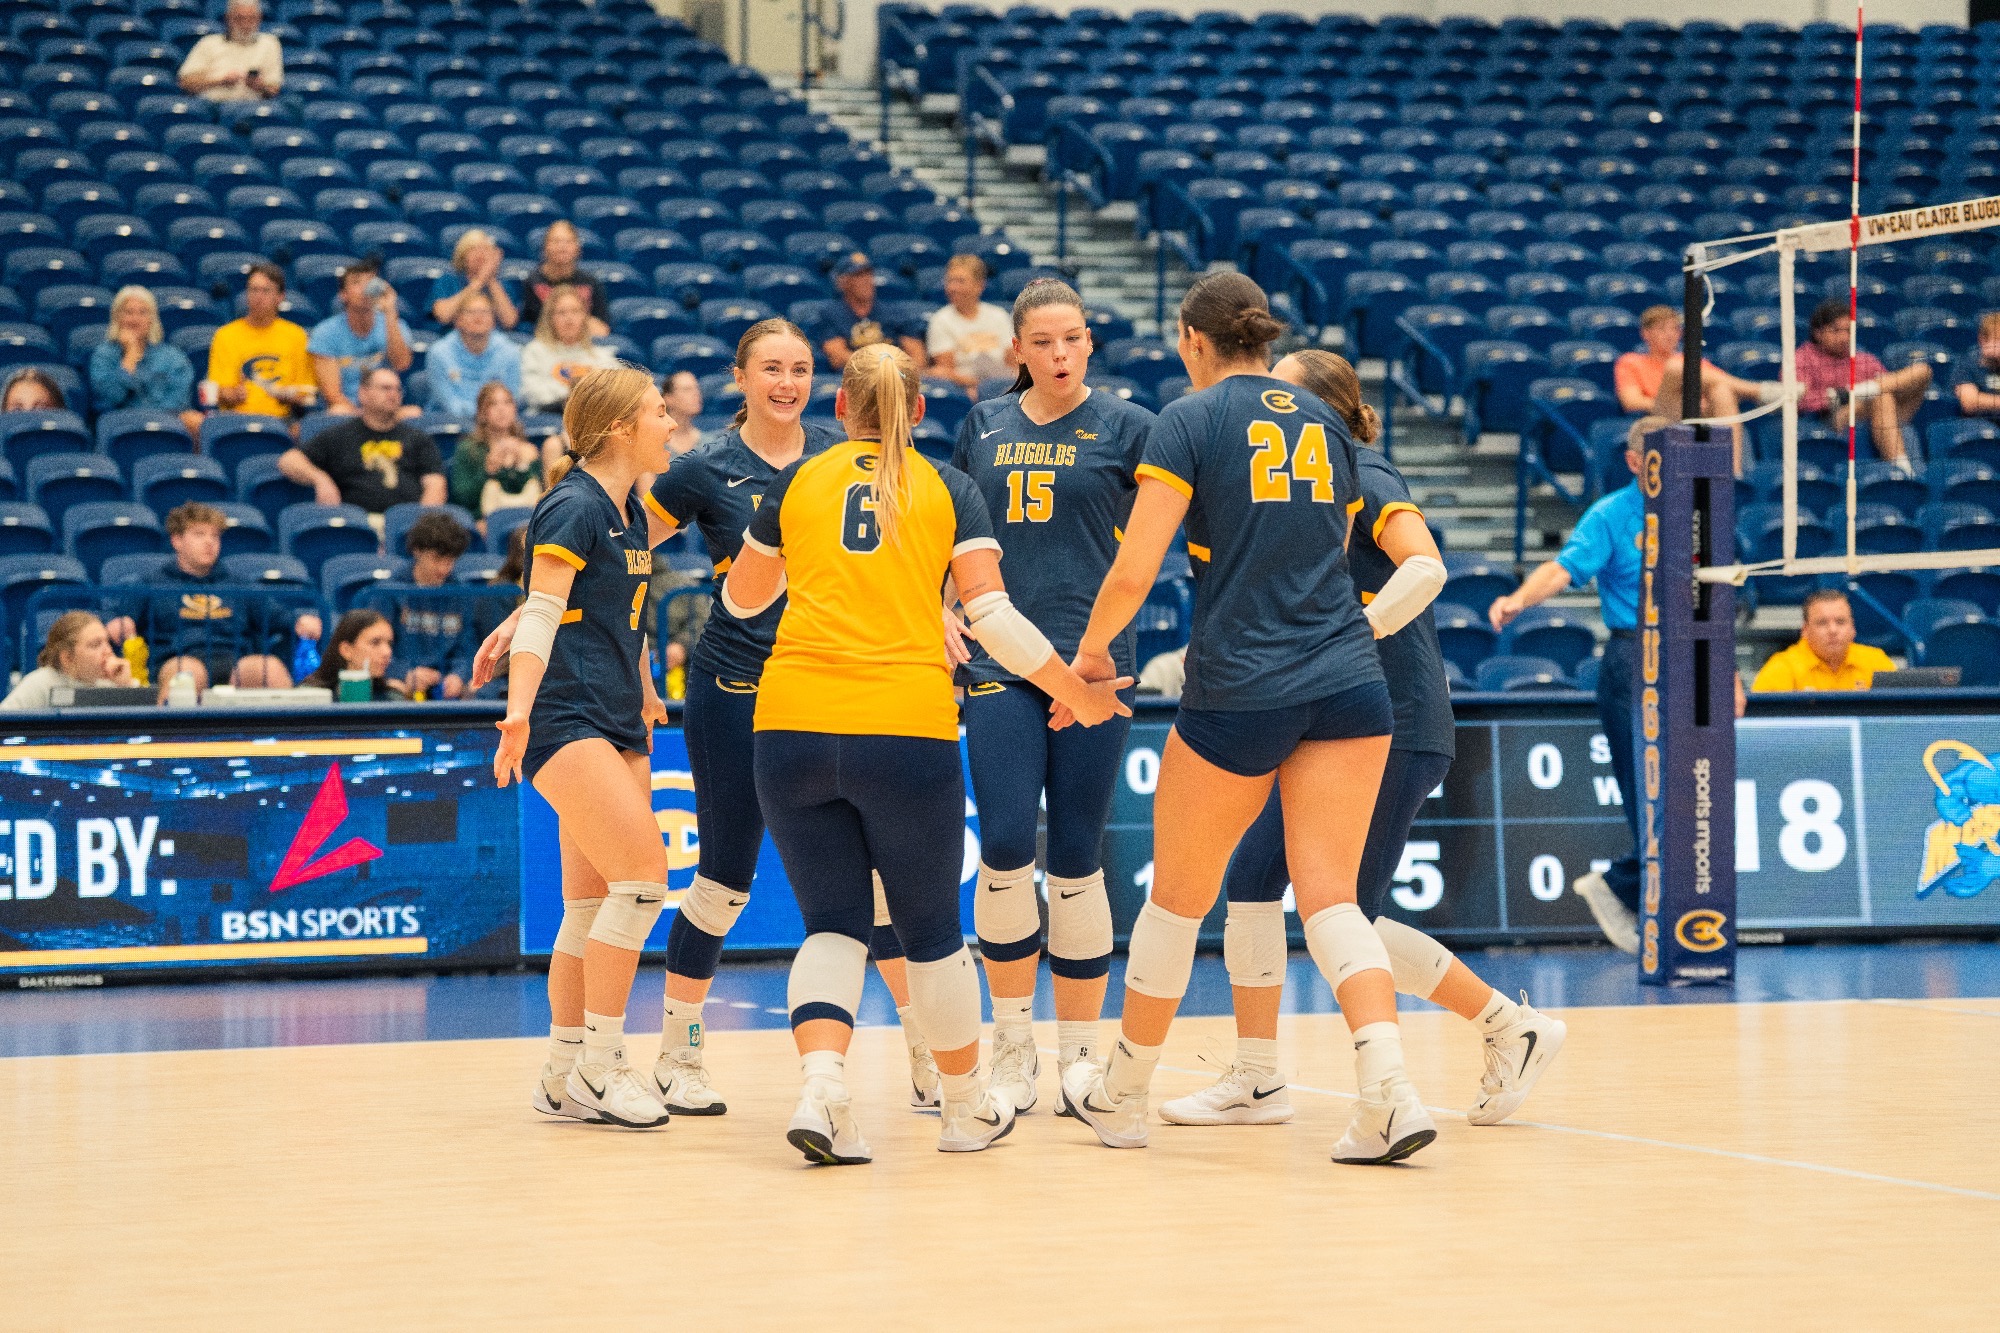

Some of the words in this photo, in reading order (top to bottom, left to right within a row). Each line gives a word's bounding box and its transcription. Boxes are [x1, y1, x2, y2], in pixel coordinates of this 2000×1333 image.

[1916, 206, 1959, 228] CLAIRE
[994, 442, 1077, 467] BLUGOLDS
[1247, 420, 1334, 503] 24
[840, 481, 883, 554] 6
[1006, 471, 1056, 523] 15
[629, 581, 648, 630] 9
[1125, 747, 1161, 795] 0
[1527, 743, 1564, 790] 0
[77, 816, 178, 898] BY:
[1390, 840, 1445, 912] 5
[1528, 854, 1565, 901] 0
